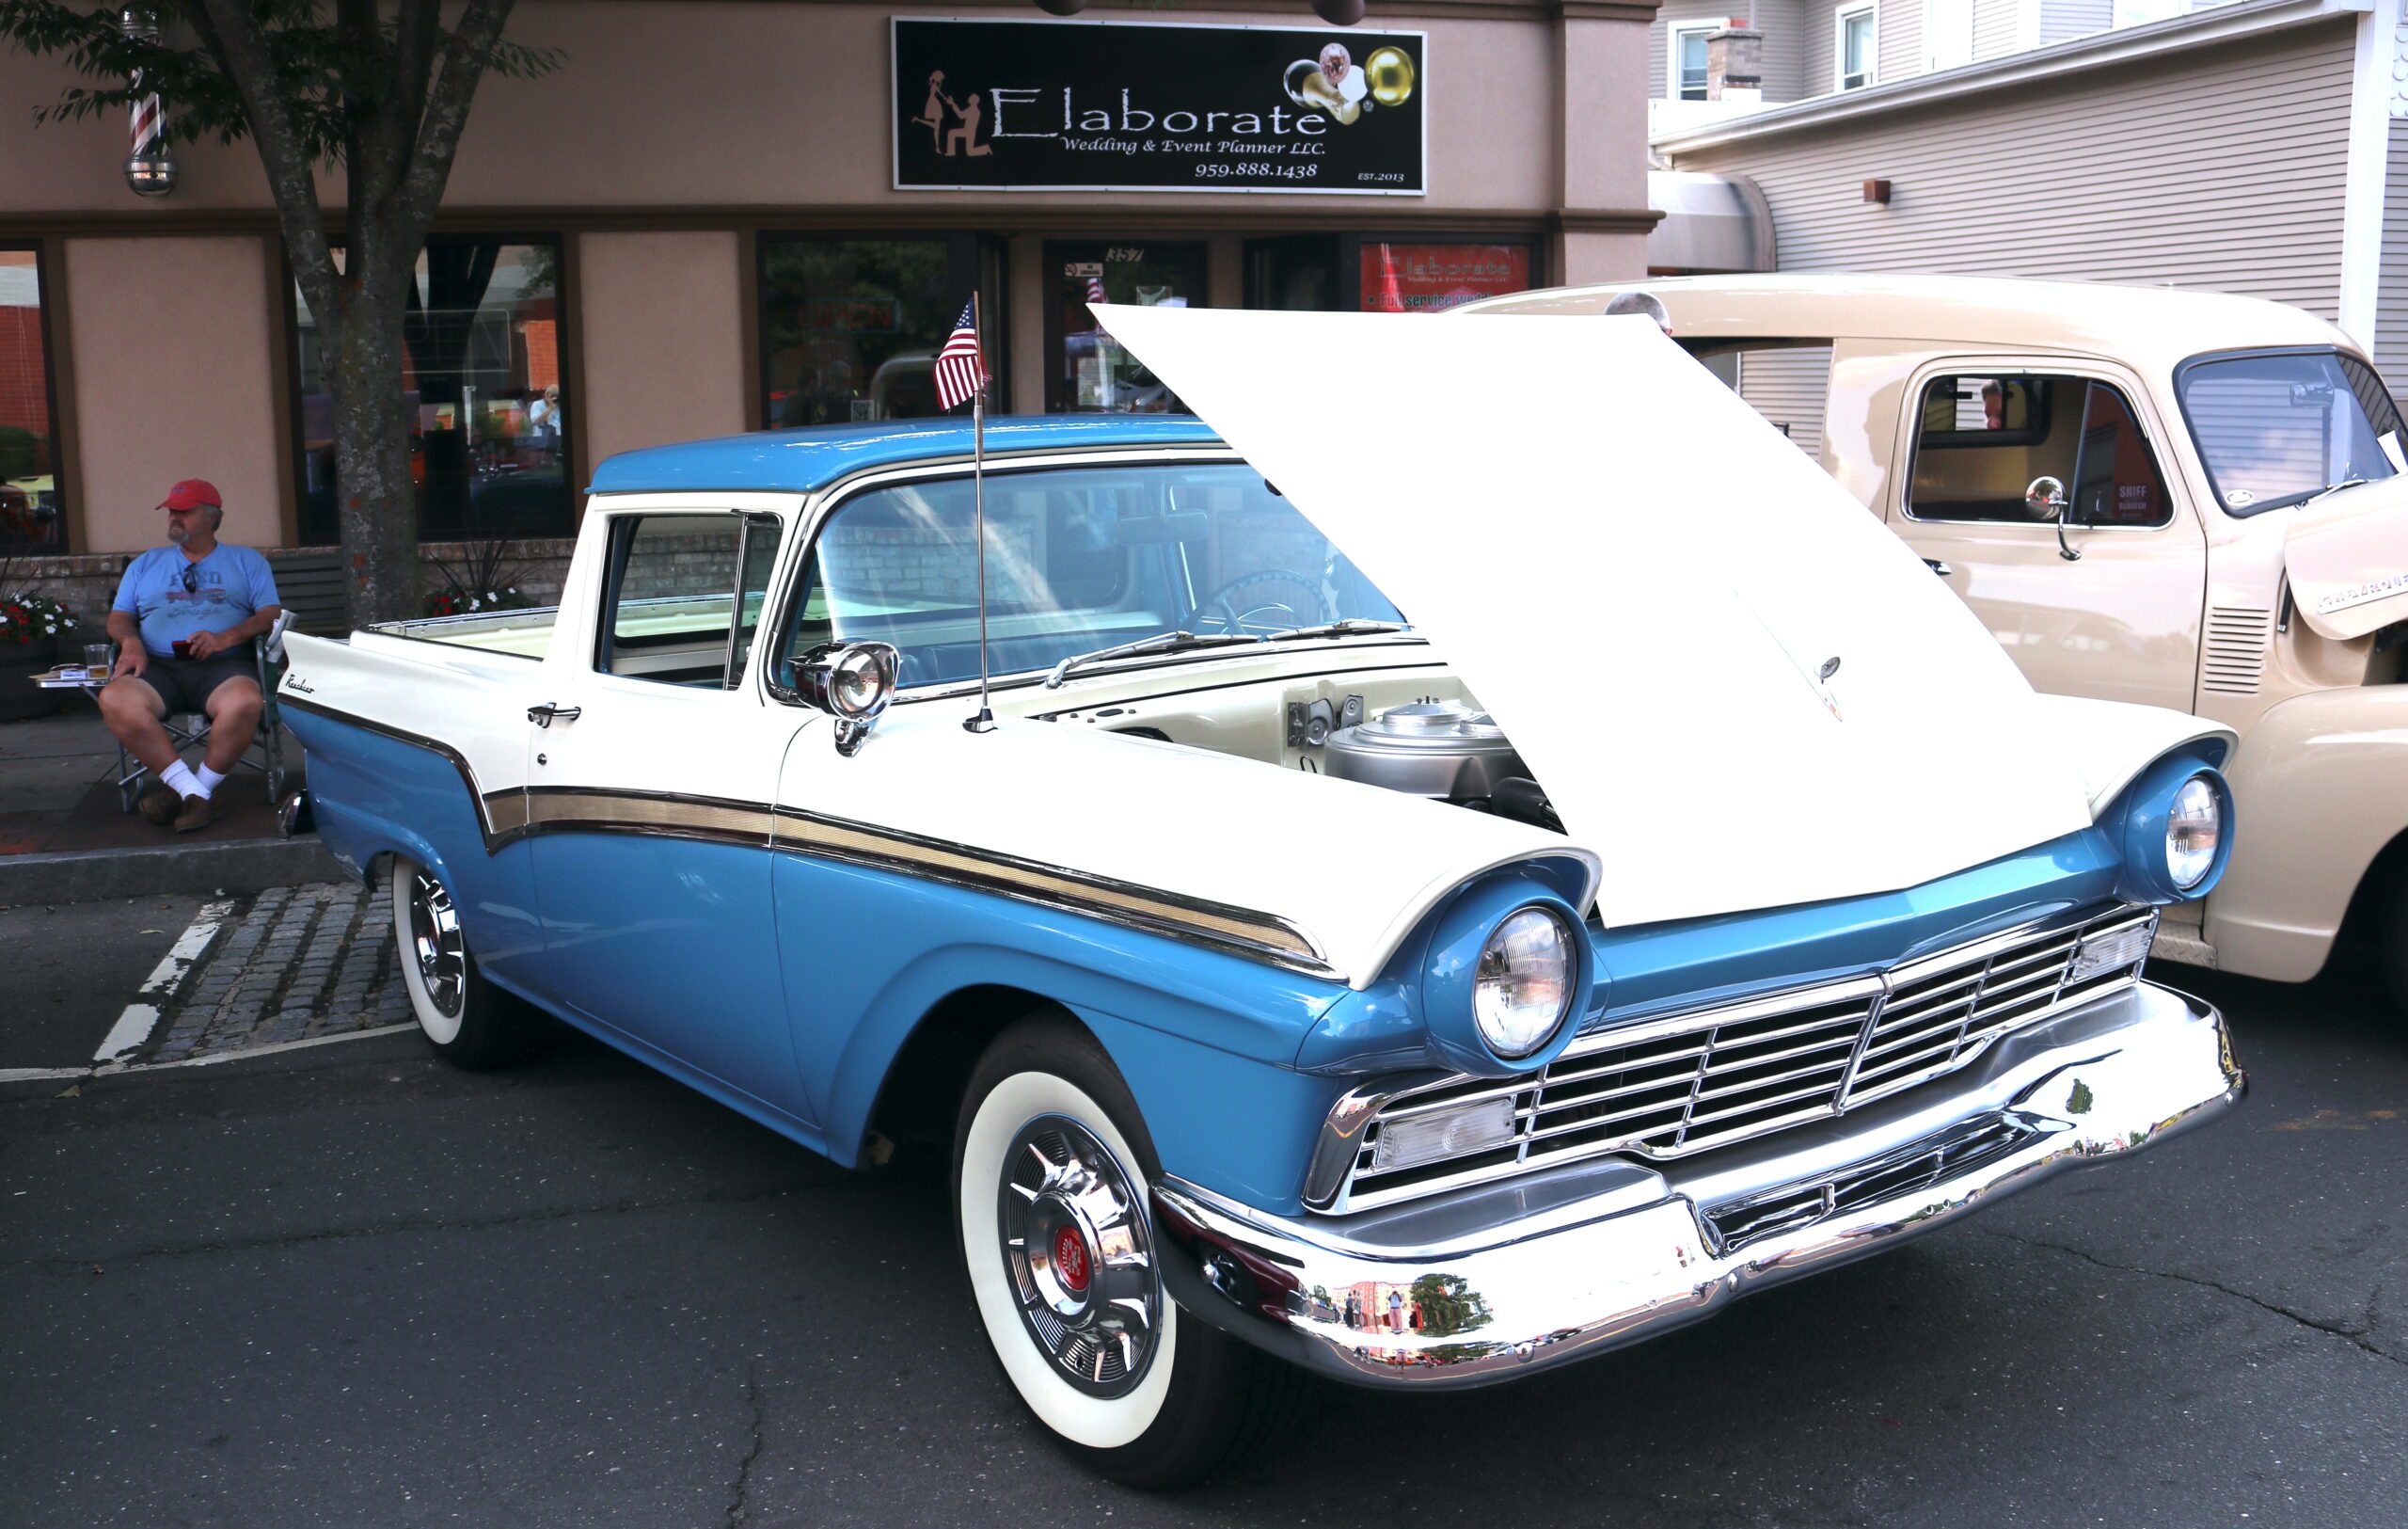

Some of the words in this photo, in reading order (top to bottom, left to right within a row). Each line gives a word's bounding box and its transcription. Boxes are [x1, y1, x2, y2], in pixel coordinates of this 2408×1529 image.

[989, 87, 1327, 137] Elaborate
[1060, 136, 1137, 155] Wedding
[1143, 139, 1156, 151] &
[1161, 140, 1212, 152] Event
[1217, 139, 1286, 153] Planner
[1289, 142, 1325, 155] LLC.
[1195, 162, 1318, 179] 959.888.1438
[1357, 172, 1404, 183] EST.2013
[1404, 295, 1452, 308] service
[2118, 485, 2147, 498] SNIFF
[170, 571, 223, 587] FRD
